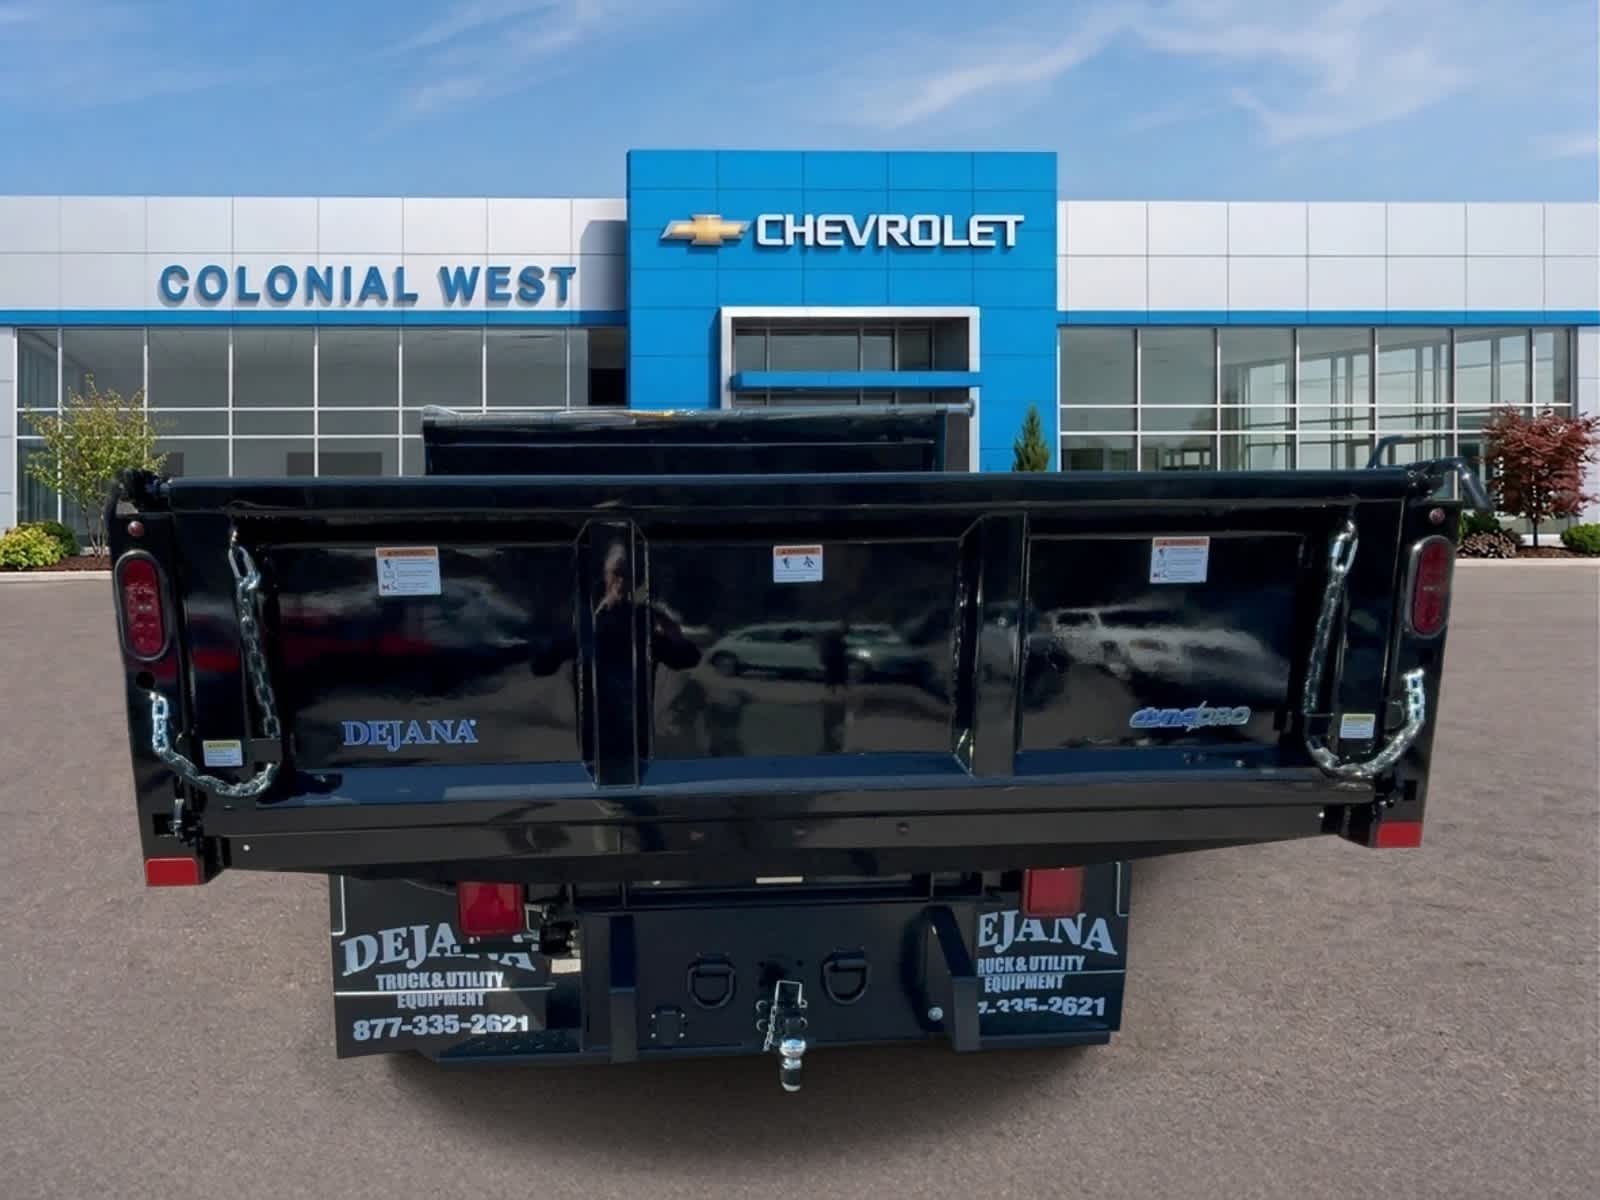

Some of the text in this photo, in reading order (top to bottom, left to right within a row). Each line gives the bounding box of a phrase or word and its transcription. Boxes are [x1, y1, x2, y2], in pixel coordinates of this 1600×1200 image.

[756, 213, 1024, 247] CHEVROLET
[159, 264, 576, 306] COLONIAL WEST
[341, 719, 479, 752] DEJANA
[340, 922, 536, 976] DEJAA
[978, 910, 1118, 956] EJANA
[397, 991, 485, 1009] EQUIPMENT
[984, 974, 1065, 994] EQUIPMENT
[353, 1015, 529, 1040] 877-335-2621
